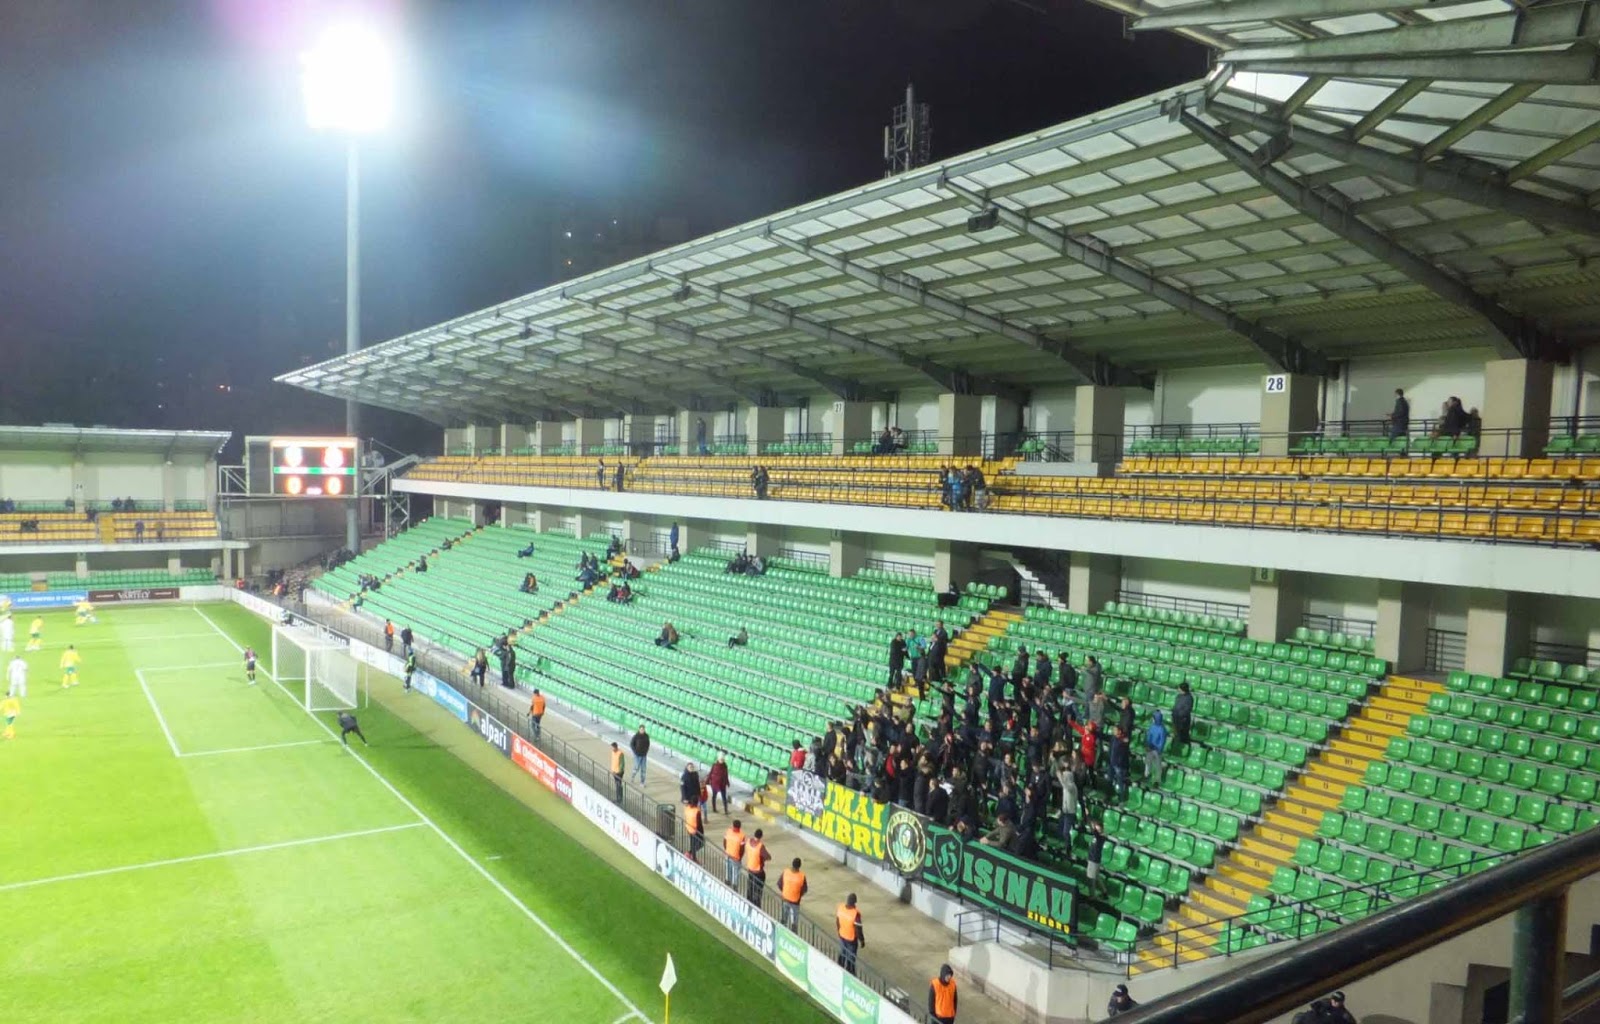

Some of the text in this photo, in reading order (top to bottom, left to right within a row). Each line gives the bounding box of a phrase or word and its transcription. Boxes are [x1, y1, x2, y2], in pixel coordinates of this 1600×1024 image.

[1267, 377, 1283, 391] 28
[835, 403, 842, 412] 27
[480, 713, 507, 750] alpari
[1027, 911, 1071, 935] ZIMBRU
